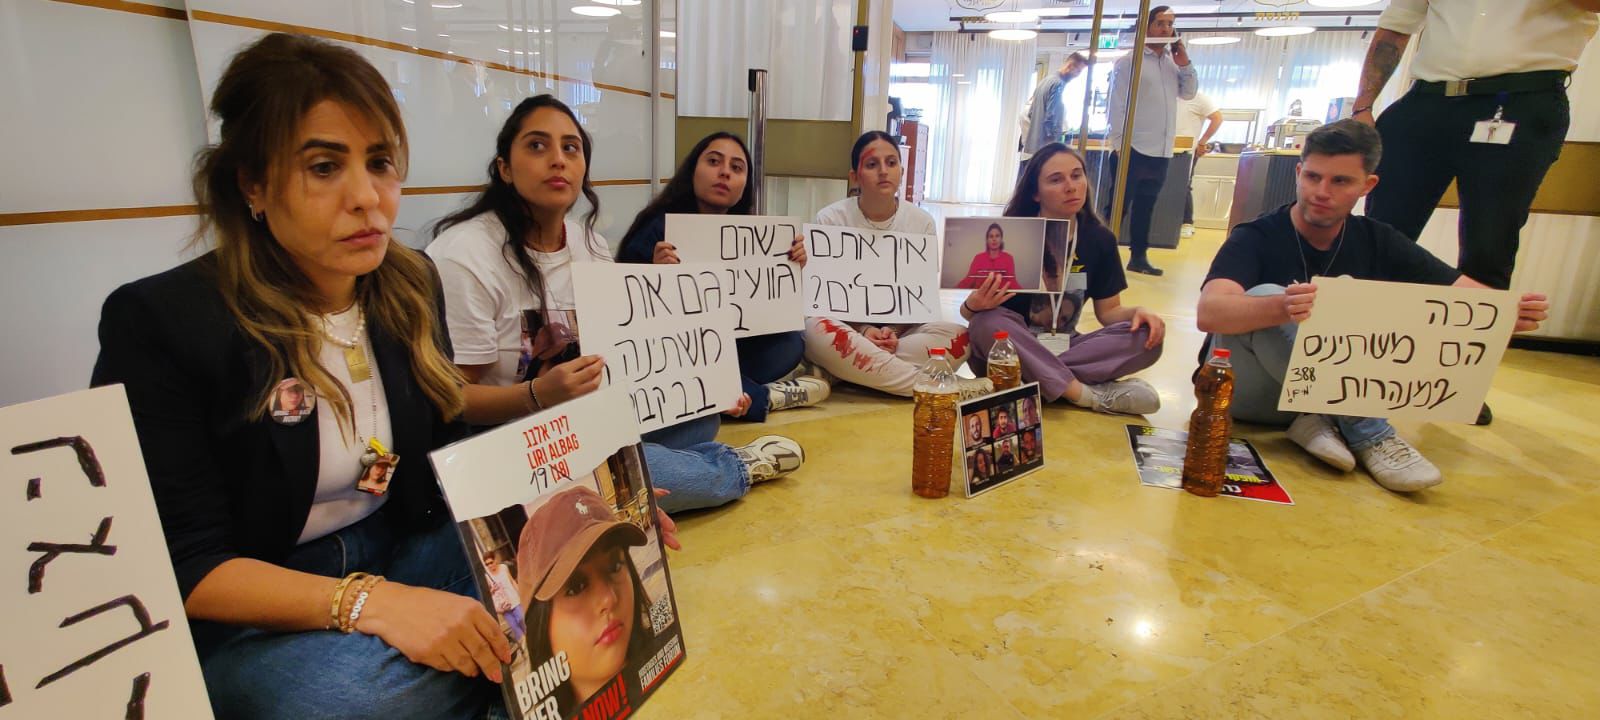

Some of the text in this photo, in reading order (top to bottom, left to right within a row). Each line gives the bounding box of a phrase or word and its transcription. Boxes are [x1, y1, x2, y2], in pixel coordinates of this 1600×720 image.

[810, 228, 927, 283] איך אתם
[618, 270, 722, 327] גם את
[810, 273, 933, 317] אוכלים?
[1424, 299, 1499, 330] ככה
[614, 327, 722, 383] משתינה
[1303, 331, 1487, 367] הם משתינים
[1289, 366, 1316, 382] 388
[1326, 375, 1458, 410] במנהרות
[522, 415, 570, 449] לירי אלבג
[527, 433, 580, 470] LIRI ALBAG
[529, 467, 548, 495] 19
[513, 650, 571, 715] BRING
